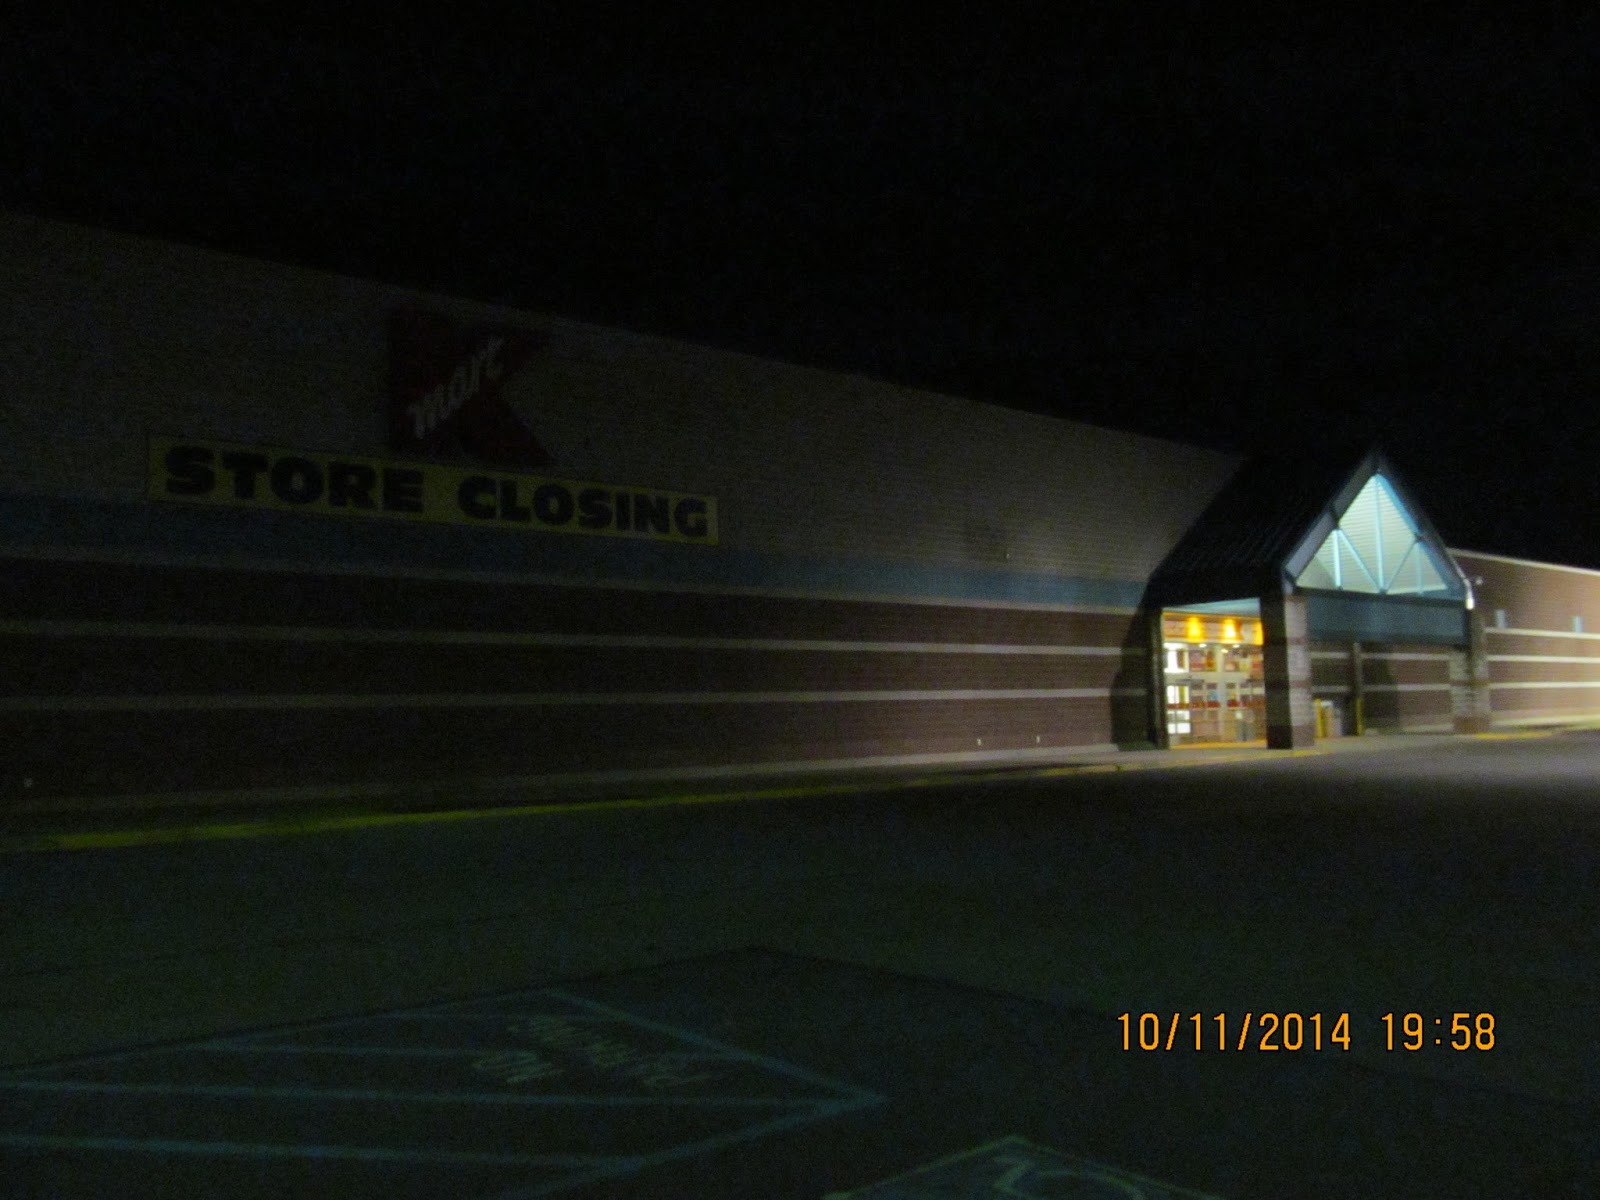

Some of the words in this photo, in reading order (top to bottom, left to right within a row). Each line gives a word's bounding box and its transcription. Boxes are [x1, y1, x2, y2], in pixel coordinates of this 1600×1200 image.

[389, 303, 556, 465] K
[164, 445, 424, 513] STORE
[457, 475, 709, 539] CLOSING
